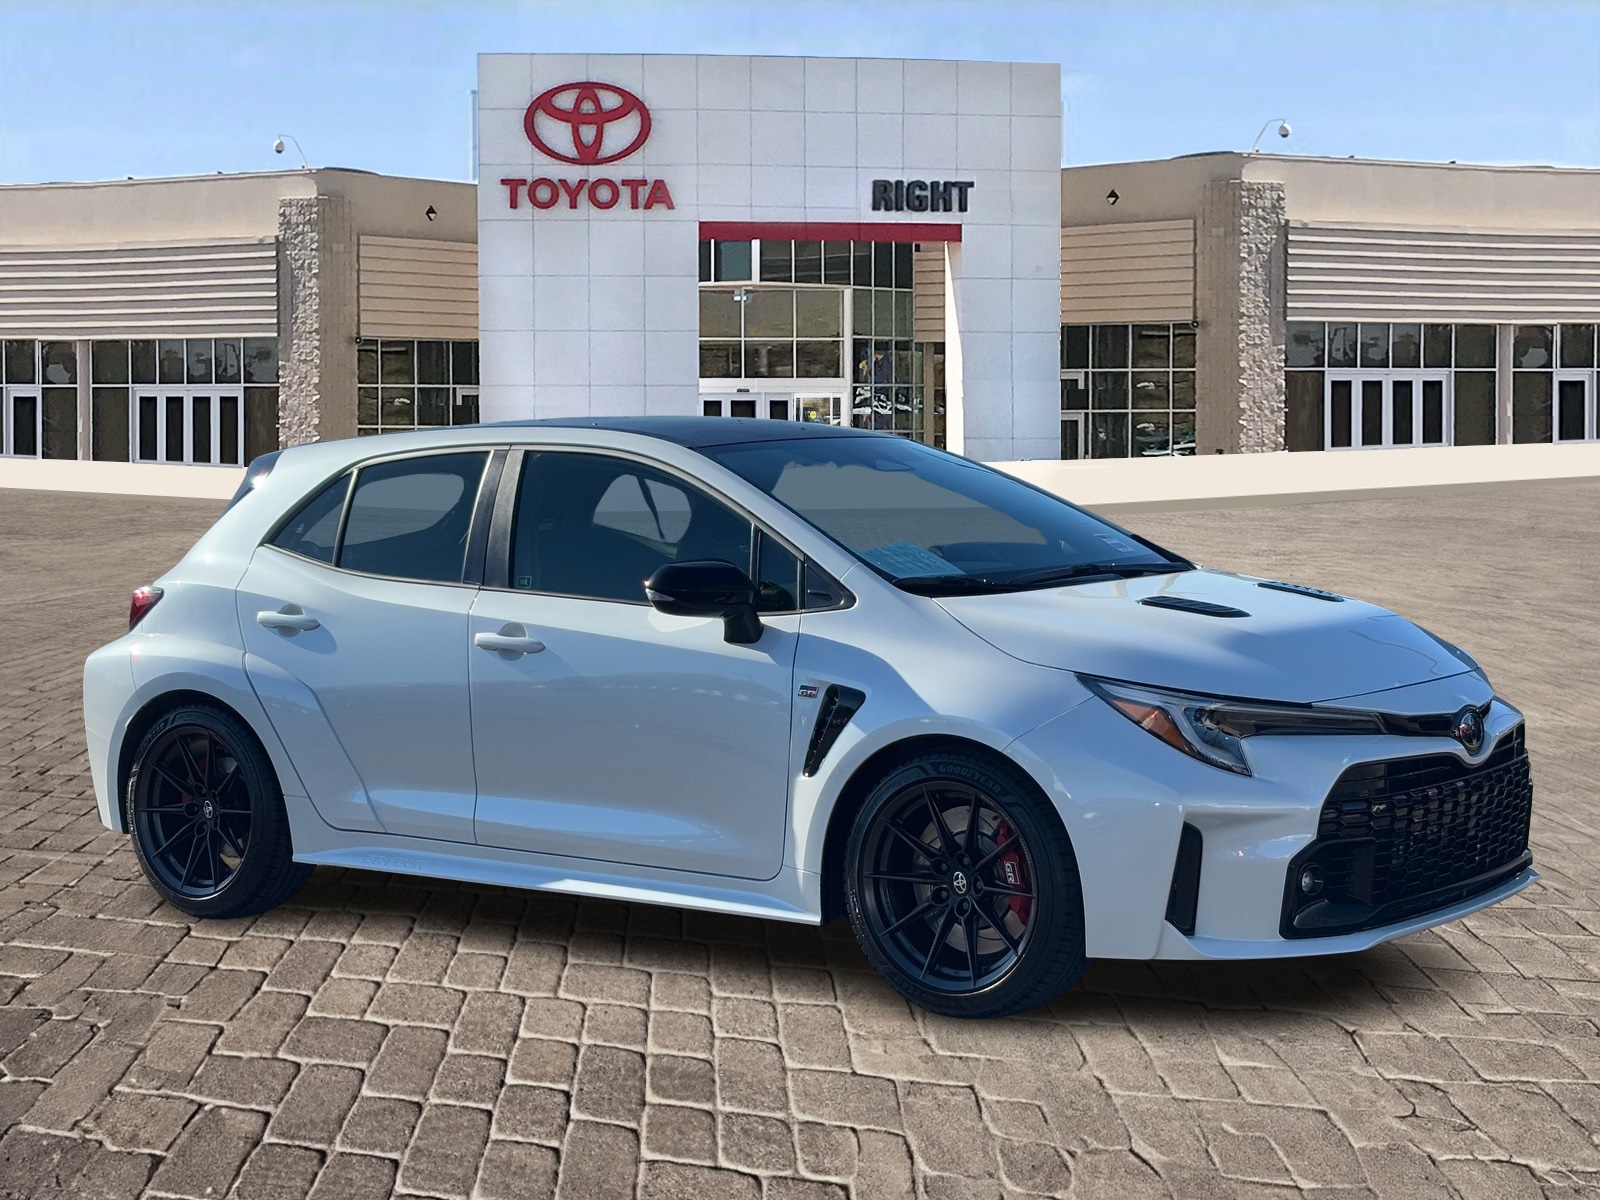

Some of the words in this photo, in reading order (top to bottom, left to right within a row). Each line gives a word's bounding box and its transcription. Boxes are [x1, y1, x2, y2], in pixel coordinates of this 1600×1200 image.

[500, 177, 676, 210] TOYOTA
[872, 179, 975, 213] RIGHT
[938, 763, 1002, 793] GOODYEAR
